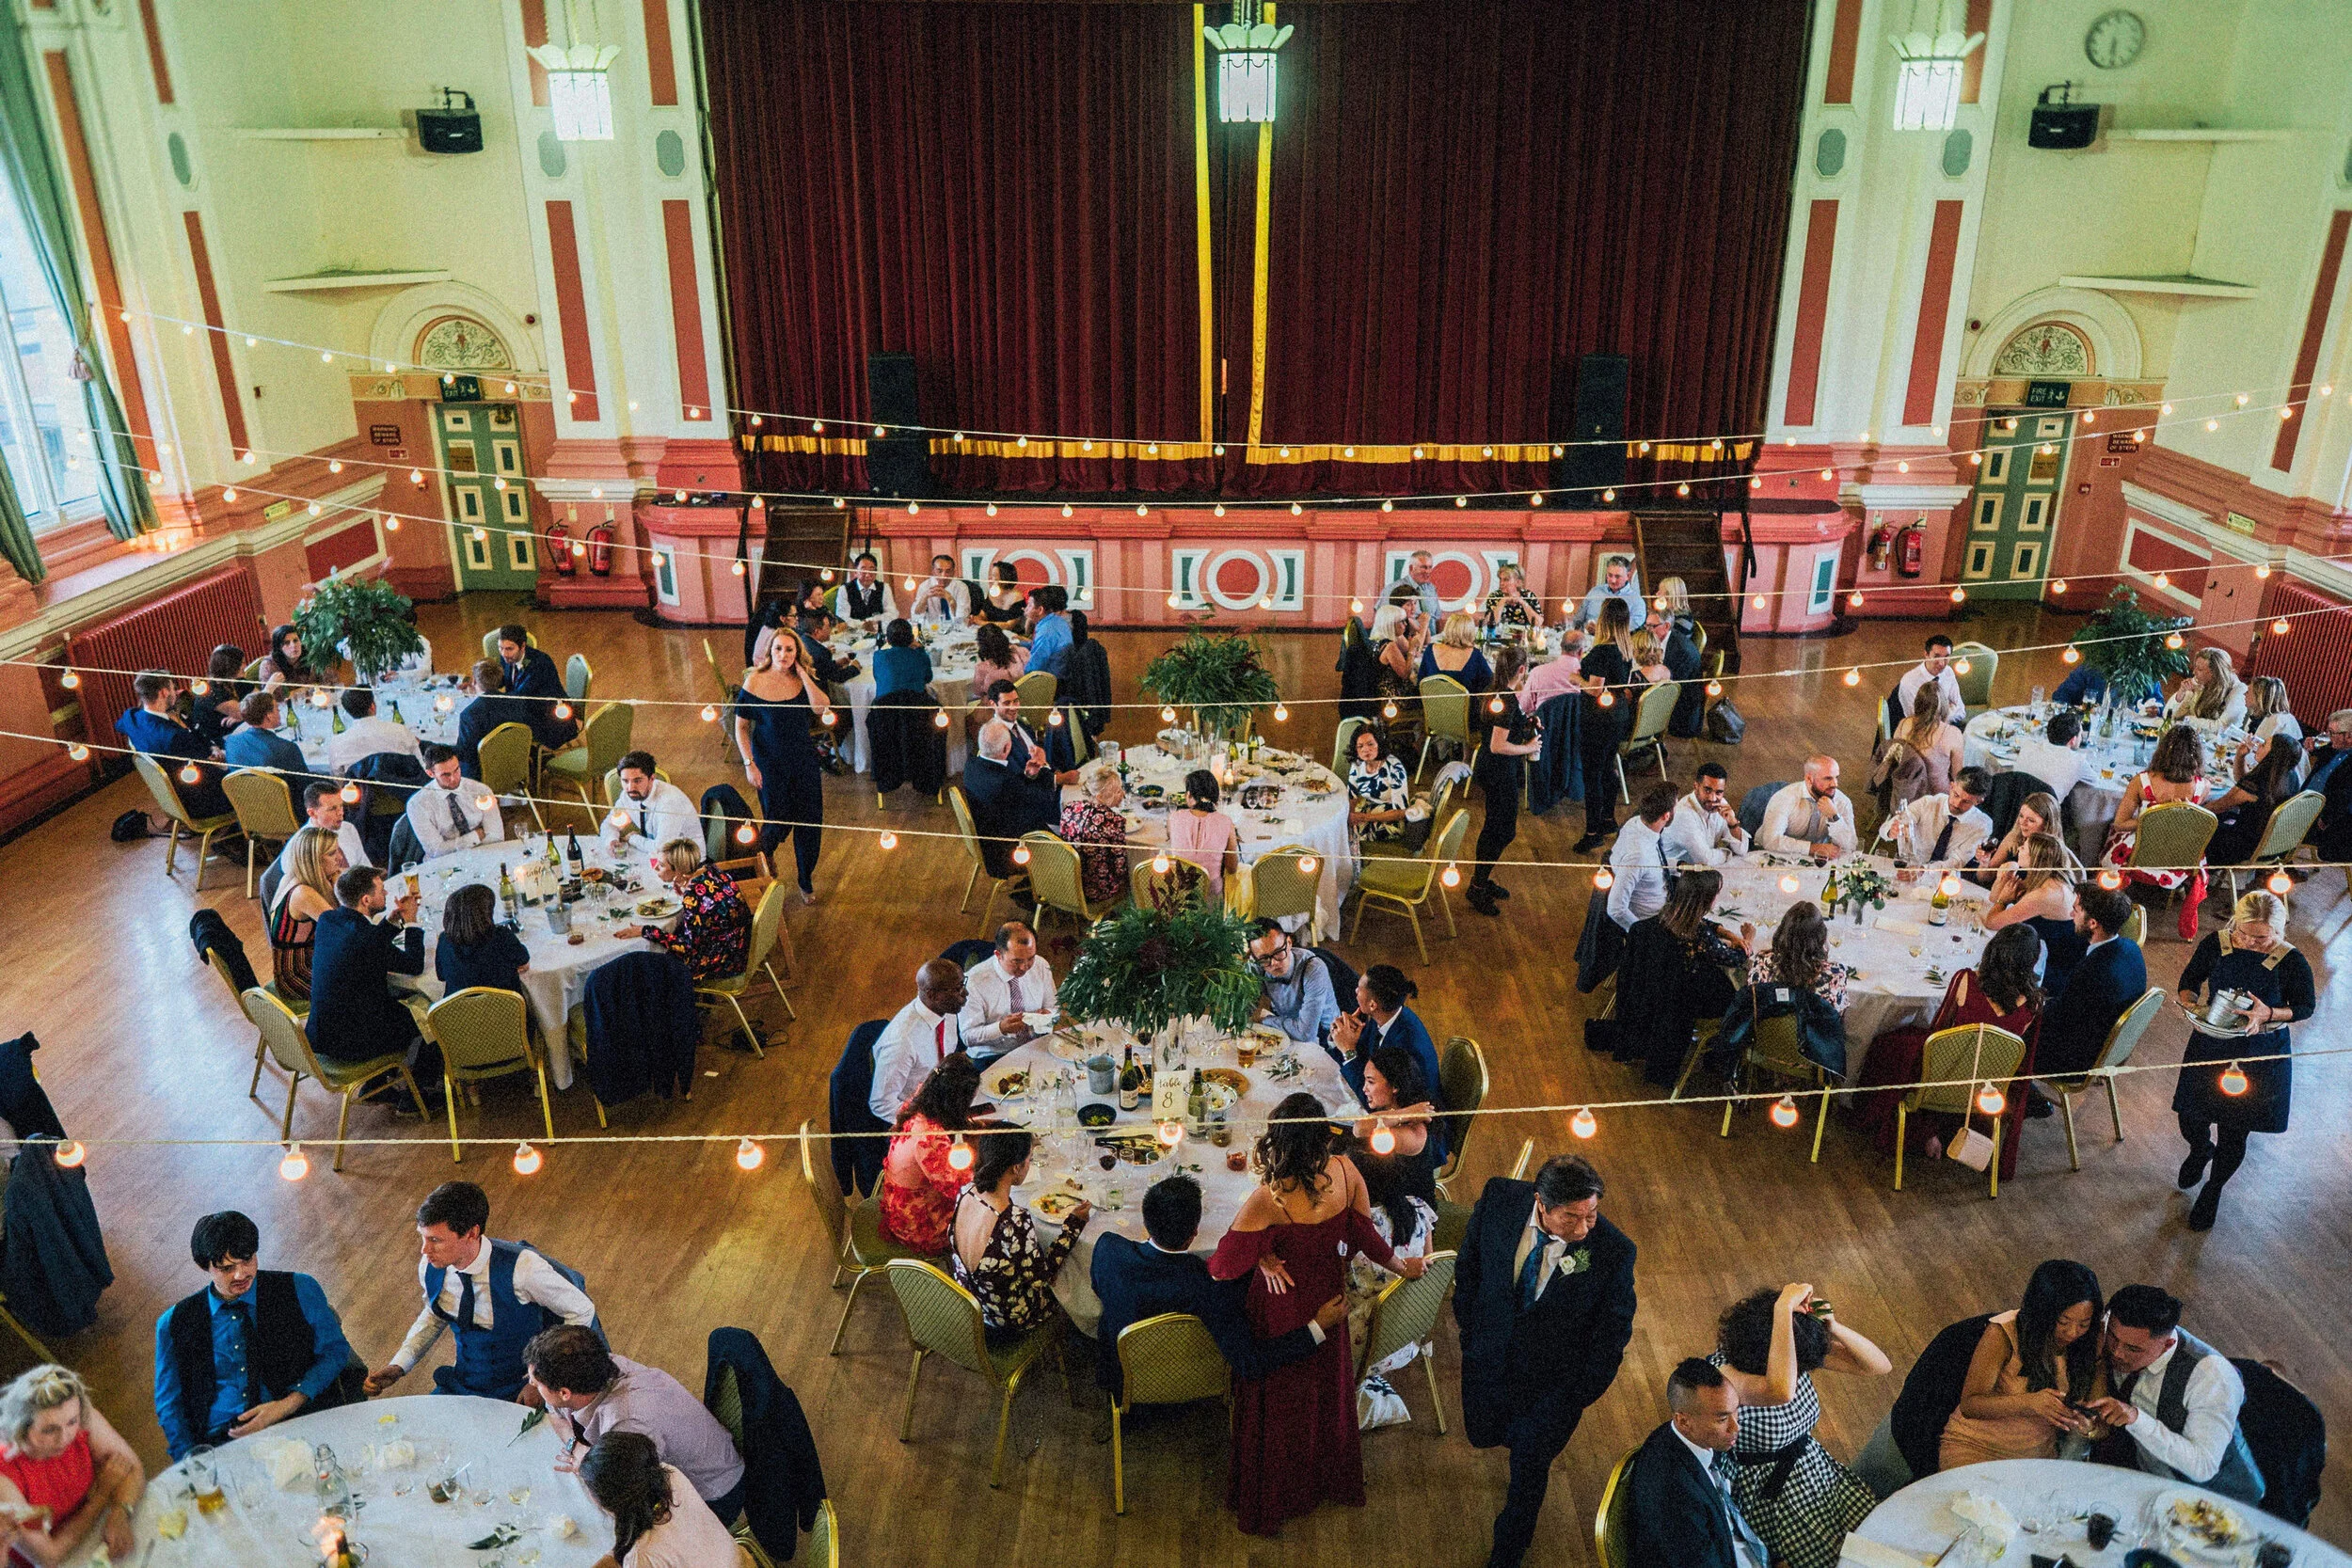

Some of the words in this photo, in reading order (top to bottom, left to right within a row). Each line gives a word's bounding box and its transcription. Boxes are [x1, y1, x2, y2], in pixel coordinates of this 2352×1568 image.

[2031, 387, 2047, 395] FIRE
[1159, 1077, 1182, 1088] table
[1162, 1091, 1173, 1109] 8
